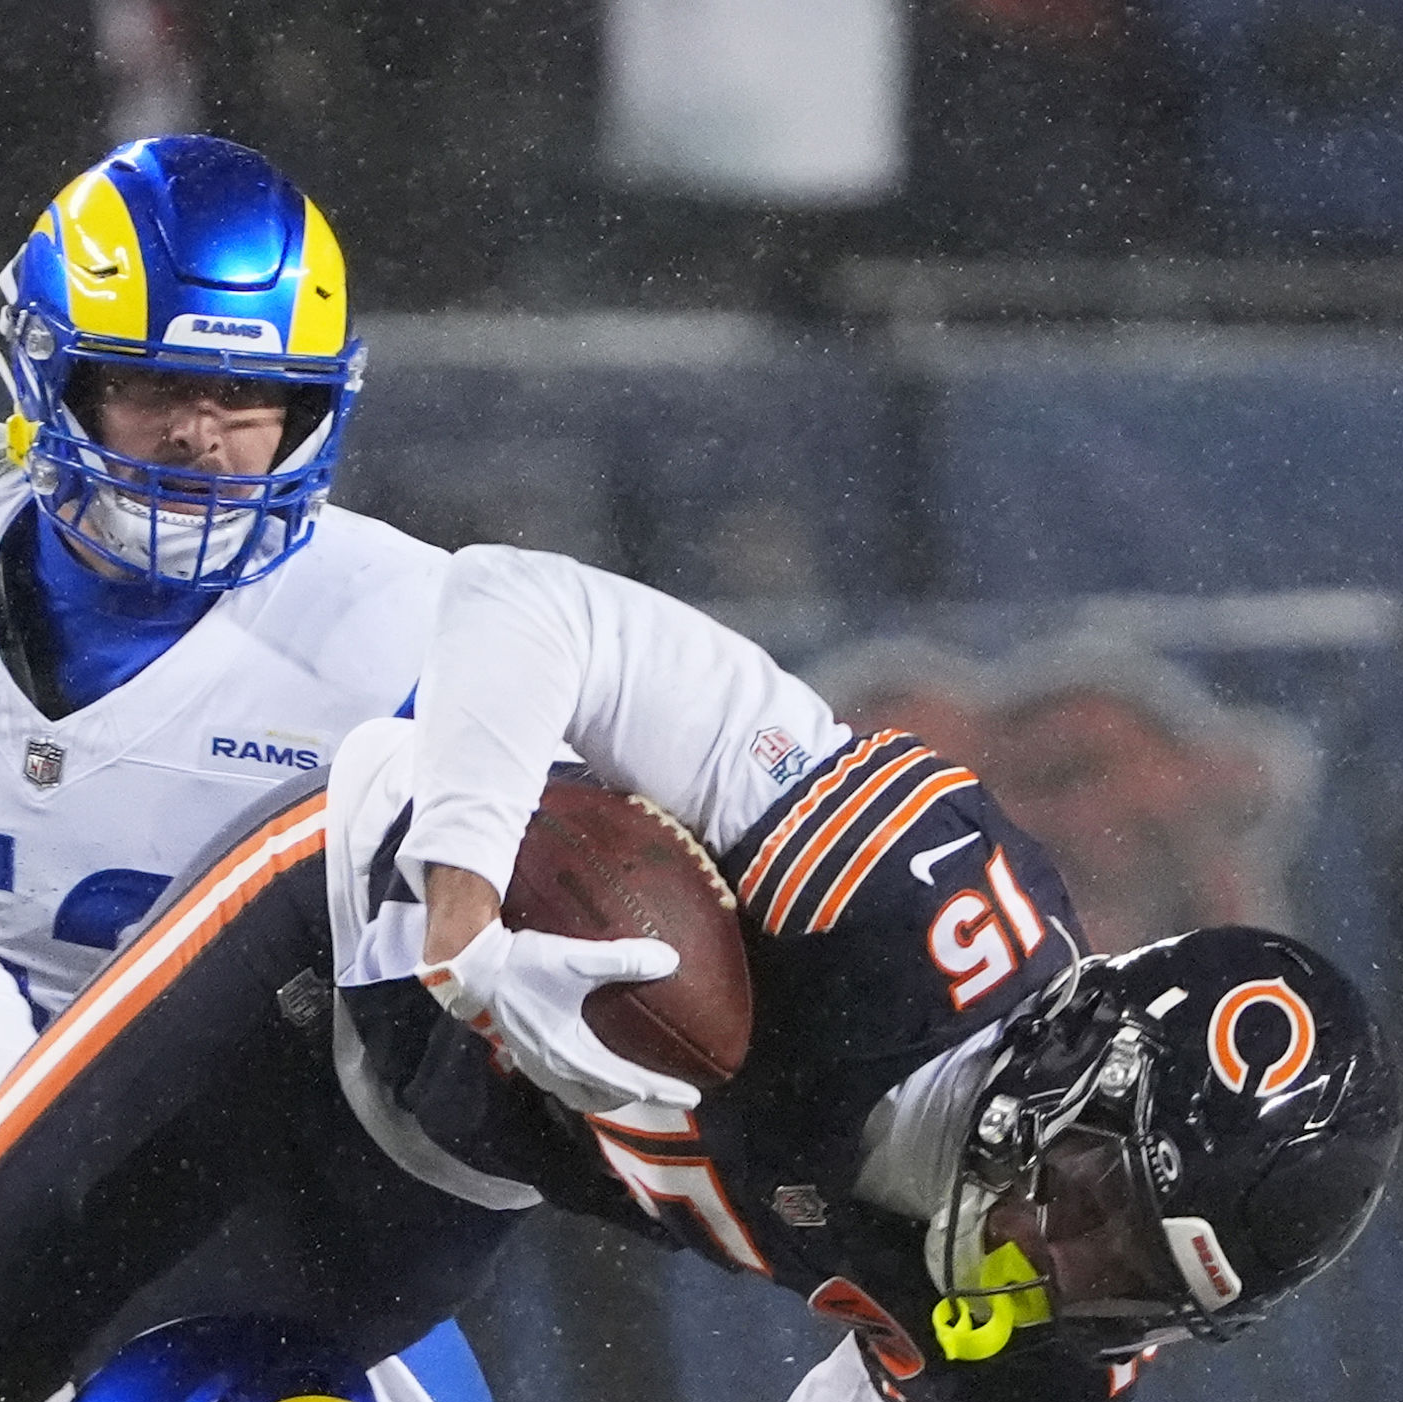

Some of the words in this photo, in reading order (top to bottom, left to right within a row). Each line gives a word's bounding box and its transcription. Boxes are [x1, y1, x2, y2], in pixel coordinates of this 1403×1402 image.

[192, 319, 263, 339] RAMS
[211, 736, 319, 771] RAMS
[927, 843, 1047, 1011] 15
